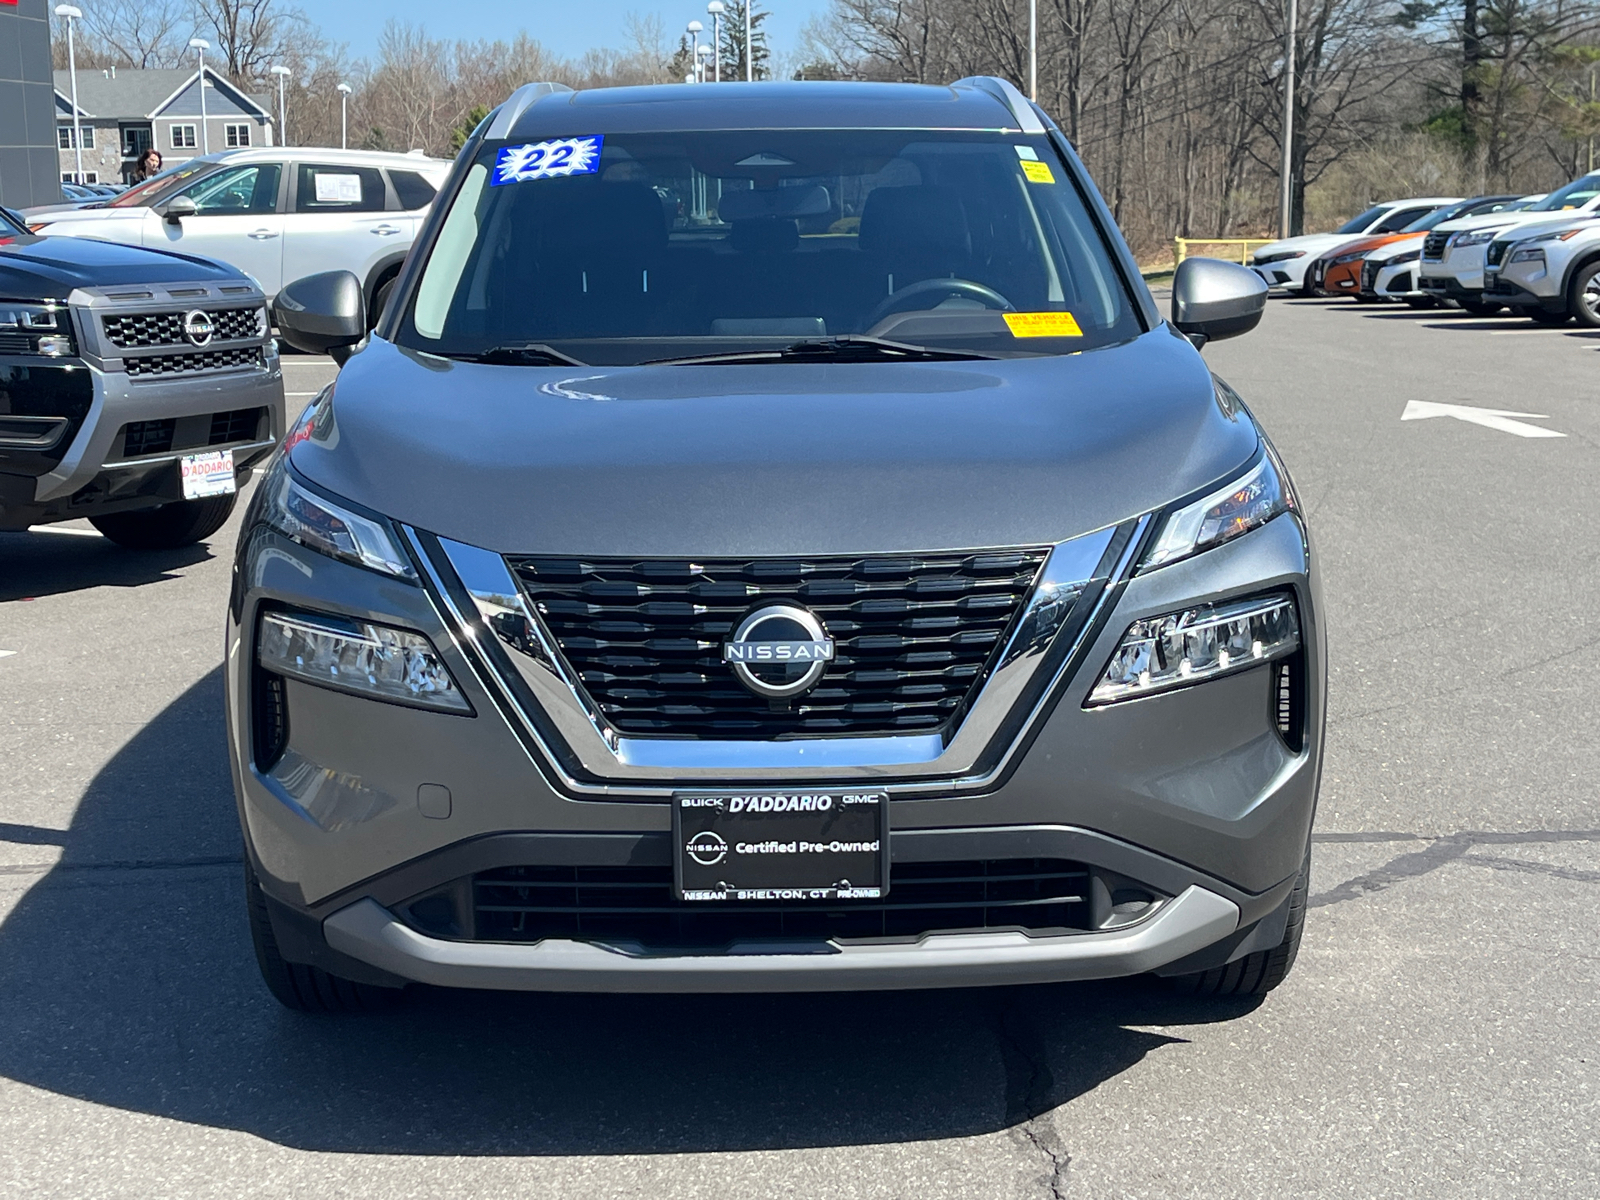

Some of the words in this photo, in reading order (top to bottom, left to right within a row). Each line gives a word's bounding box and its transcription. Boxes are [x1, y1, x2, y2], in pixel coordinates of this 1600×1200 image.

[517, 145, 574, 173] 22
[182, 459, 232, 477] D'ADDARIO
[727, 644, 830, 659] NISSAN
[681, 798, 724, 807] BUICK
[729, 794, 832, 813] D'ADDARIO
[842, 794, 879, 804] GMC
[685, 844, 728, 852] NISSAN
[735, 841, 796, 853] Certified
[799, 840, 880, 853] Pre-Owned
[684, 891, 727, 900] NISSAN
[737, 890, 806, 899] SHELTON,
[809, 890, 829, 898] CT
[837, 889, 880, 898] PRE-OWNED
